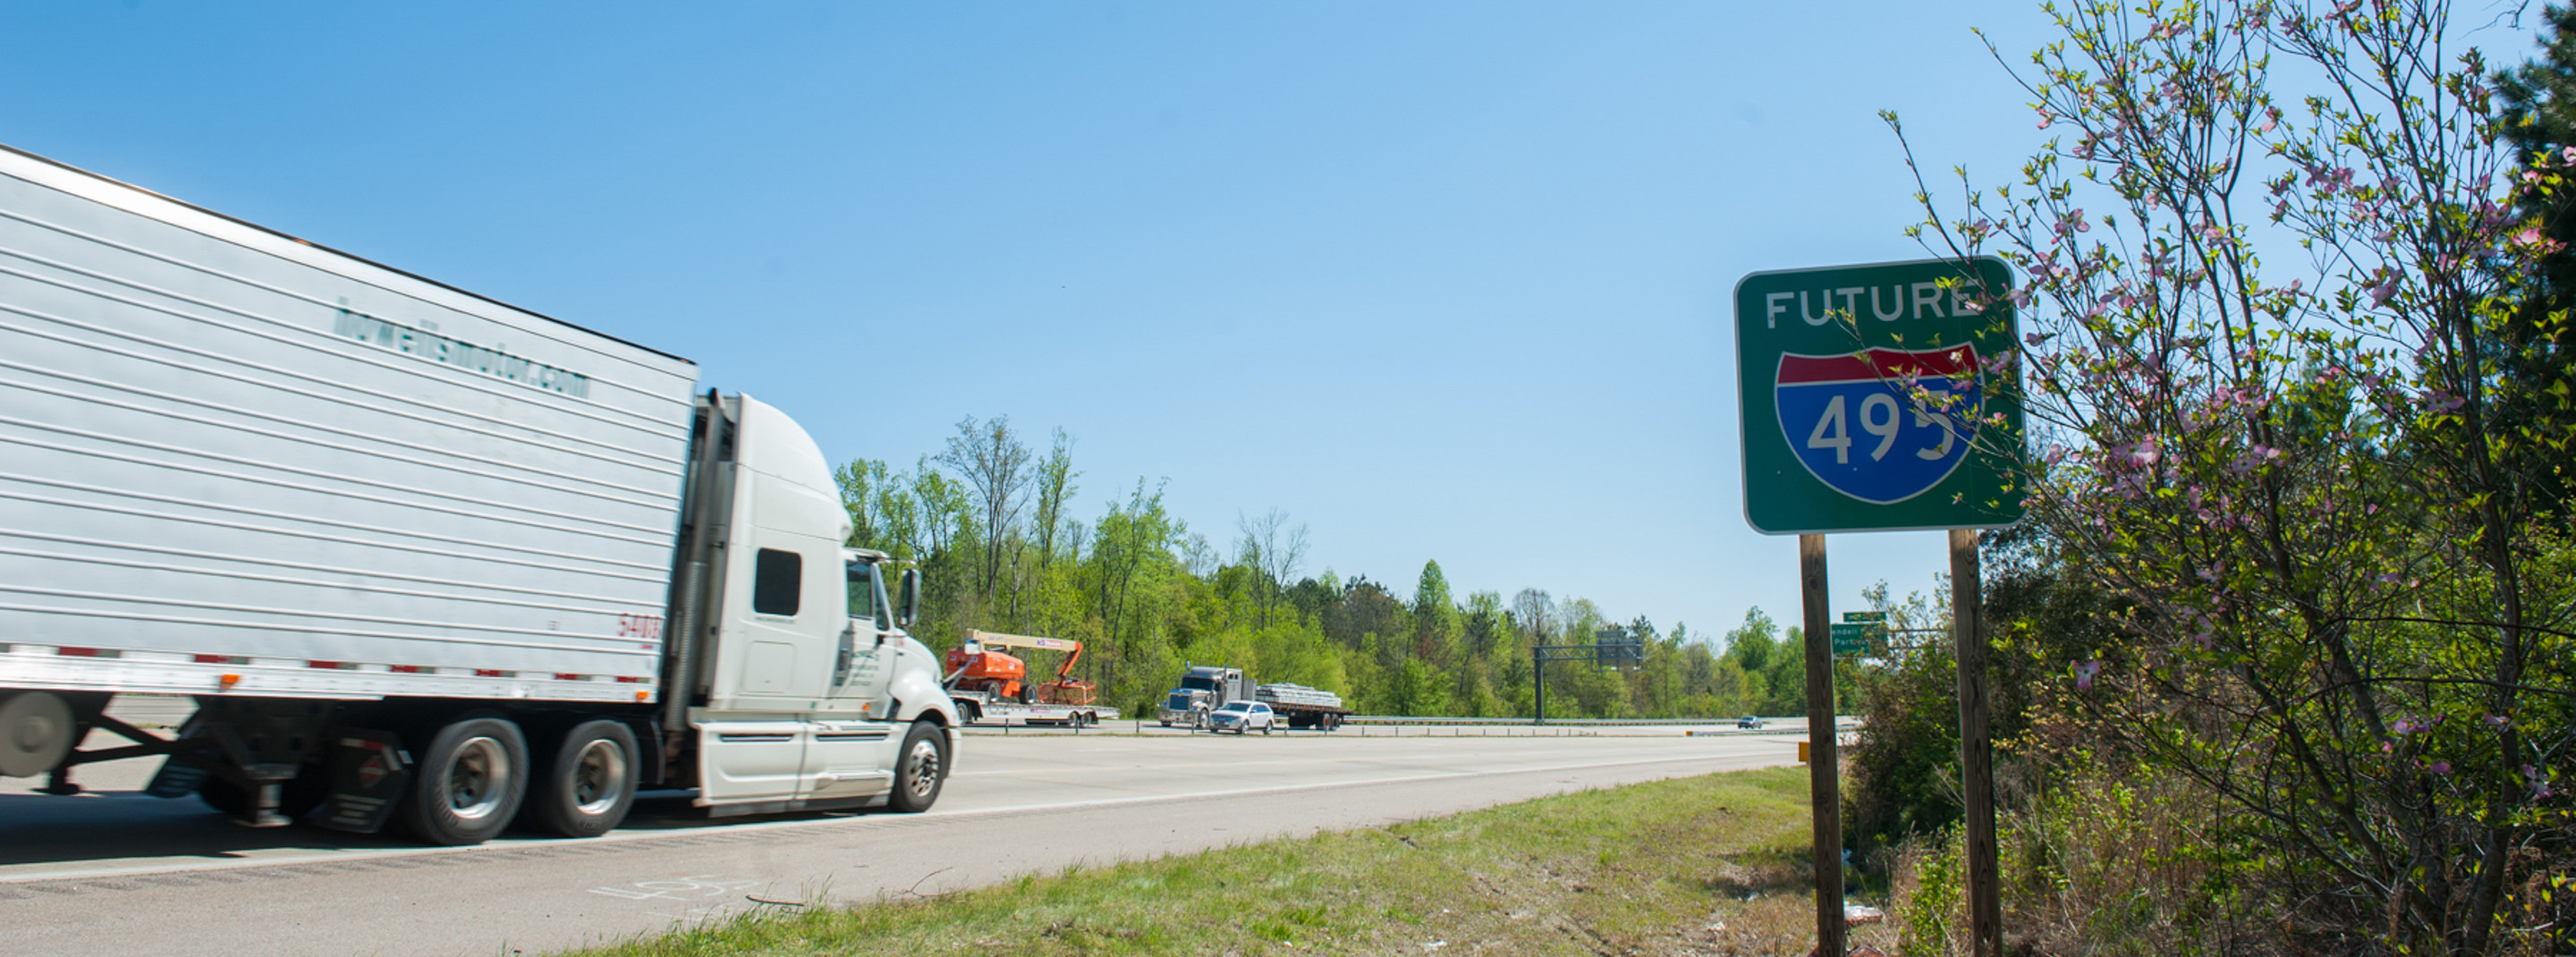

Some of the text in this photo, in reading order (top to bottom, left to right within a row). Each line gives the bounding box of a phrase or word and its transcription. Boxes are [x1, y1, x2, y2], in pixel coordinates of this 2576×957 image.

[1766, 278, 1981, 329] FUTURE
[1807, 390, 1956, 465] 495
[1831, 628, 1858, 636] endell
